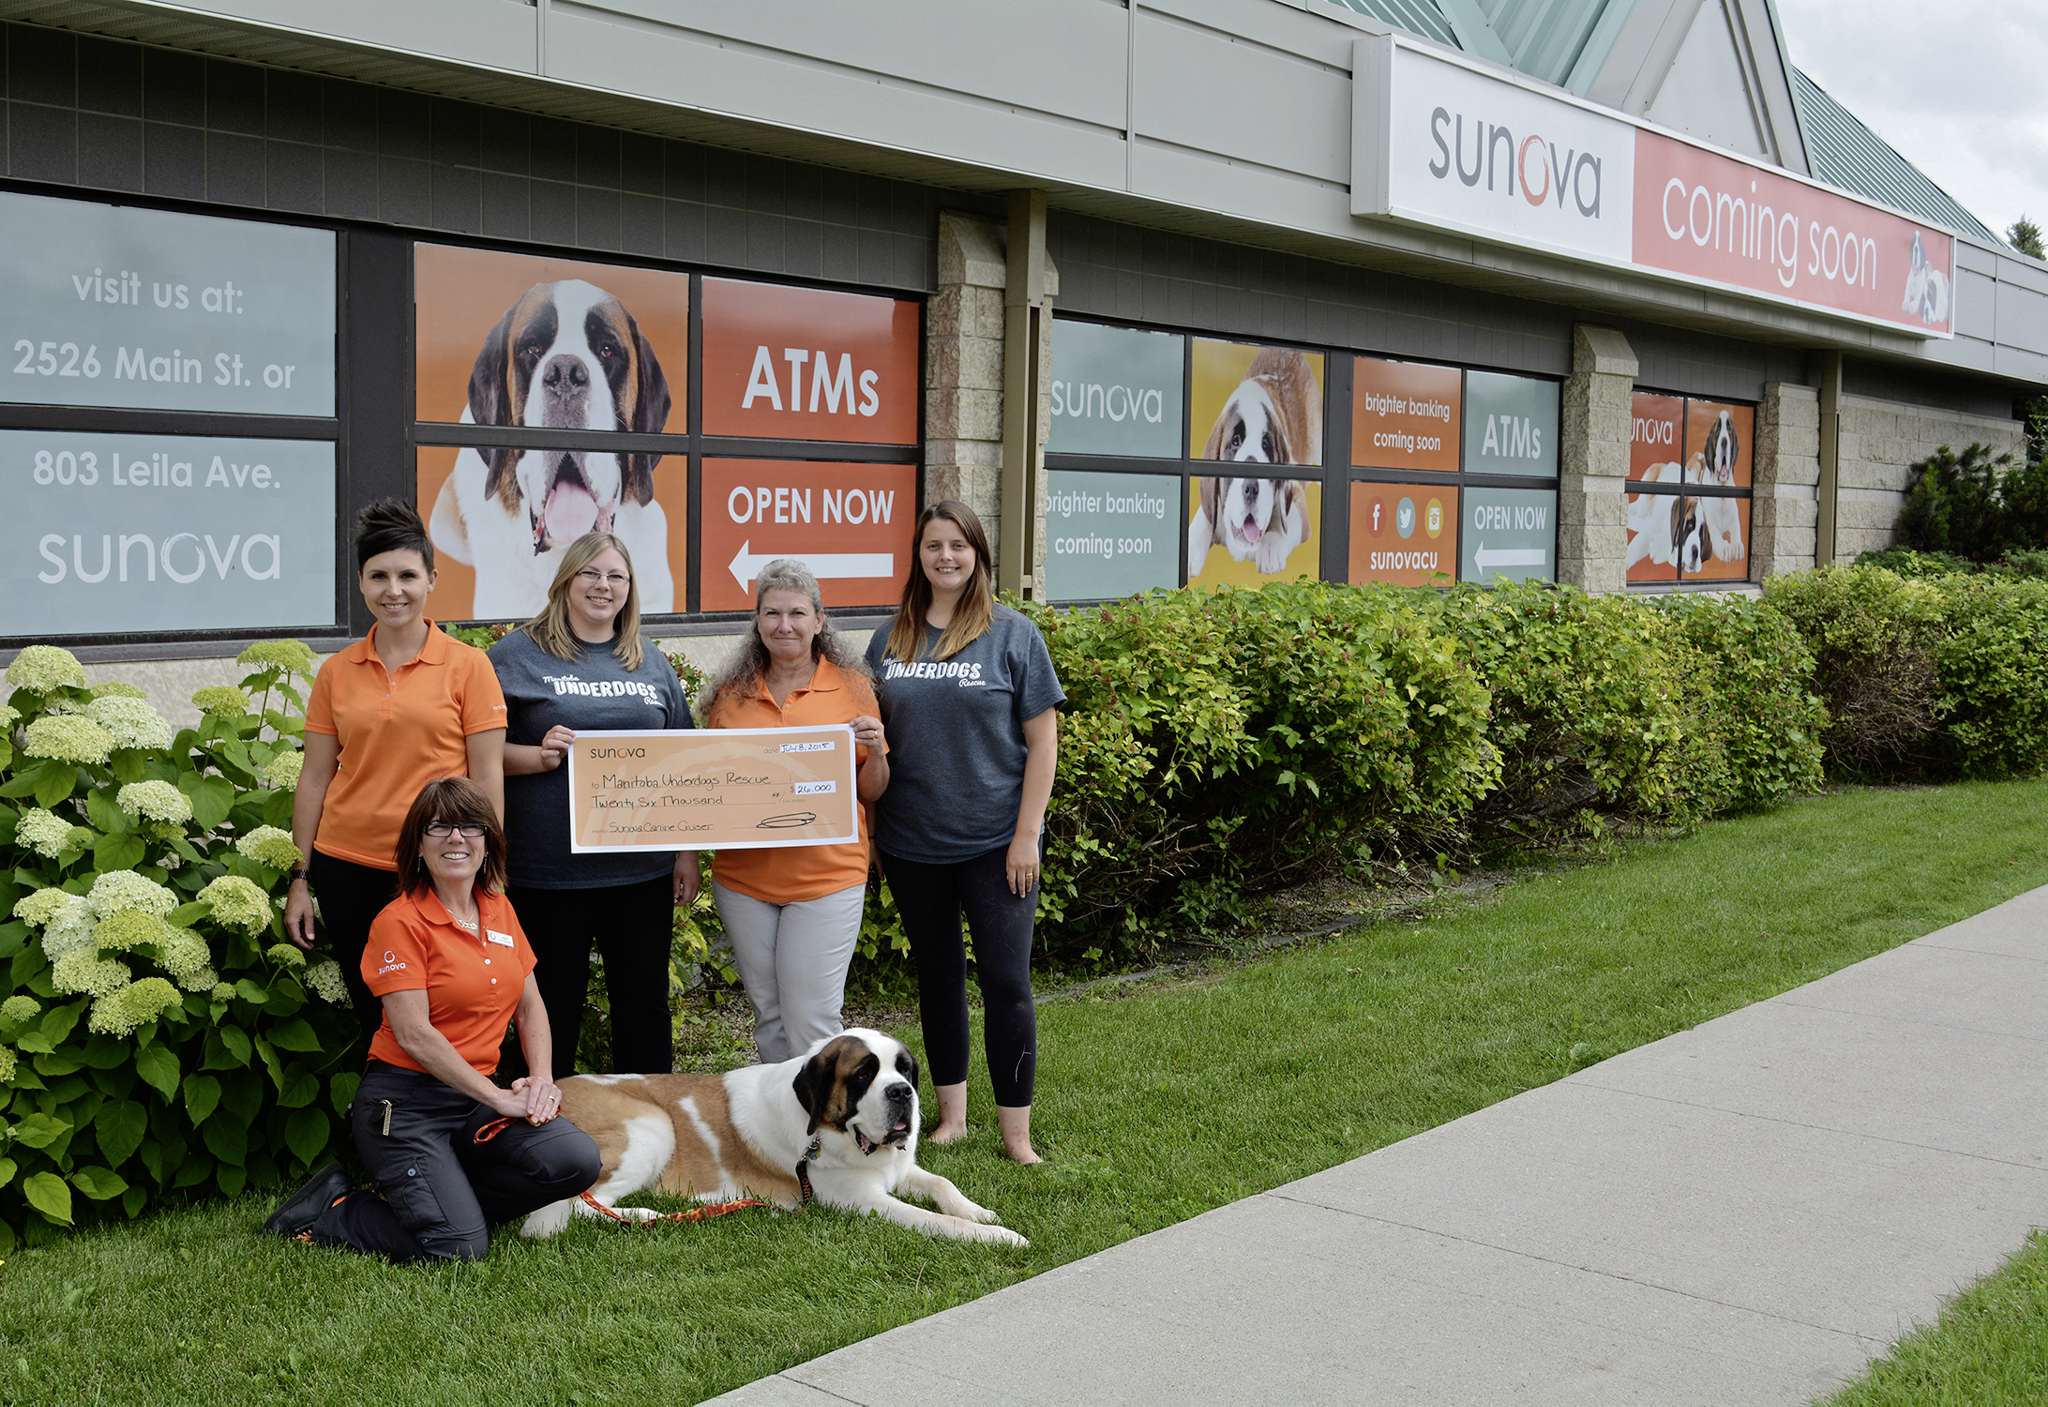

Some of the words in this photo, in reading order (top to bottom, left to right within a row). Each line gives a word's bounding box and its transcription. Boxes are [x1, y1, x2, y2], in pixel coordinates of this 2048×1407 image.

[1428, 106, 1602, 219] sunova
[1662, 177, 1799, 289] coming
[1807, 218, 1877, 290] soon
[72, 268, 142, 305] visit
[152, 281, 190, 310] us
[201, 281, 244, 314] at:
[13, 339, 101, 378] 2526
[114, 347, 202, 384] Main
[213, 352, 251, 387] St.
[263, 362, 296, 389] or
[741, 345, 879, 417] ATMs
[1050, 380, 1163, 423] sunova
[1365, 392, 1407, 417] brighter
[1409, 397, 1450, 423] banking
[1374, 430, 1414, 453] coming
[1416, 433, 1441, 451] soon
[1482, 414, 1541, 459] ATMs
[33, 450, 99, 486] 803
[112, 452, 192, 487] Leila
[204, 455, 281, 489] Ave.
[728, 486, 811, 524] OPEN
[822, 489, 894, 524] NOW
[1106, 492, 1165, 519] banking
[1474, 506, 1512, 530] OPEN
[1515, 507, 1547, 530] NOW
[37, 532, 280, 584] sunova
[1055, 533, 1113, 559] coming
[1117, 536, 1152, 554] soon
[1370, 551, 1438, 570] sunovacu
[885, 662, 982, 680] UNDERDOGS
[553, 681, 658, 700] UNDERDOGS
[590, 747, 645, 759] sunova
[602, 773, 659, 789] Manitoba
[661, 773, 720, 791] Underdogs
[726, 772, 770, 785] Rescue
[592, 795, 635, 810] Twenty
[638, 796, 657, 808] Six
[660, 794, 723, 808] Thousand
